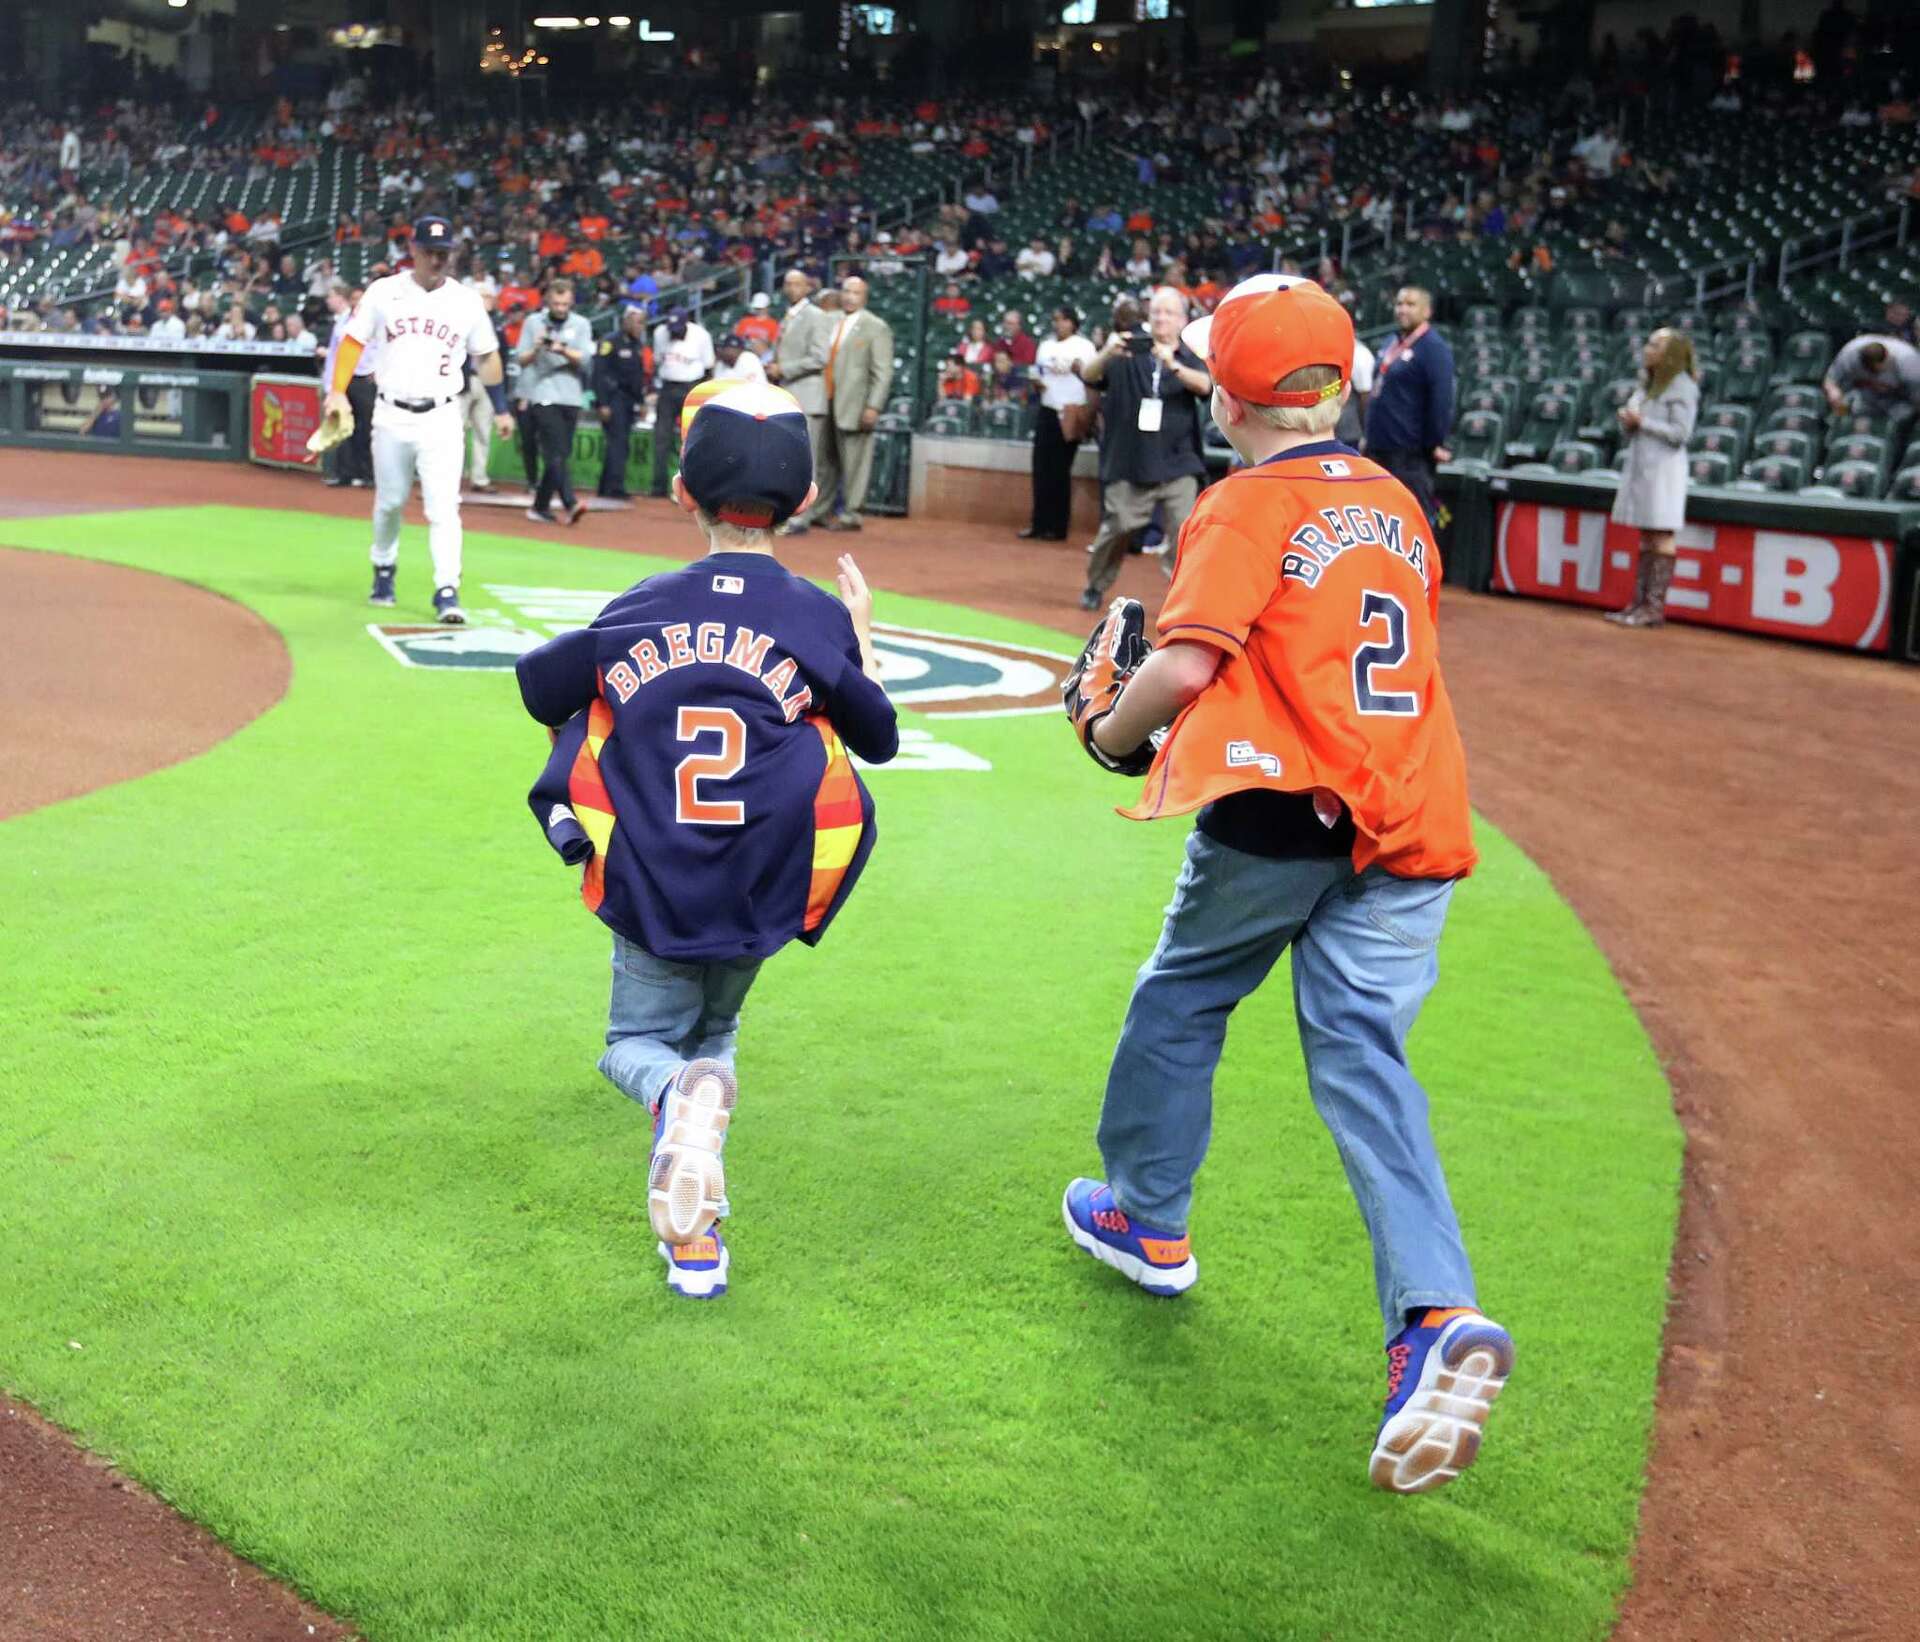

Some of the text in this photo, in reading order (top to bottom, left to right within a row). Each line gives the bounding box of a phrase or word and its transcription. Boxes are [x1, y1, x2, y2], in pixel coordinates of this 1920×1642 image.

[385, 317, 460, 348] ASTROS
[439, 354, 451, 376] 2
[1281, 505, 1431, 598] BREGMA
[1351, 588, 1420, 717] 2
[674, 705, 747, 825] 2
